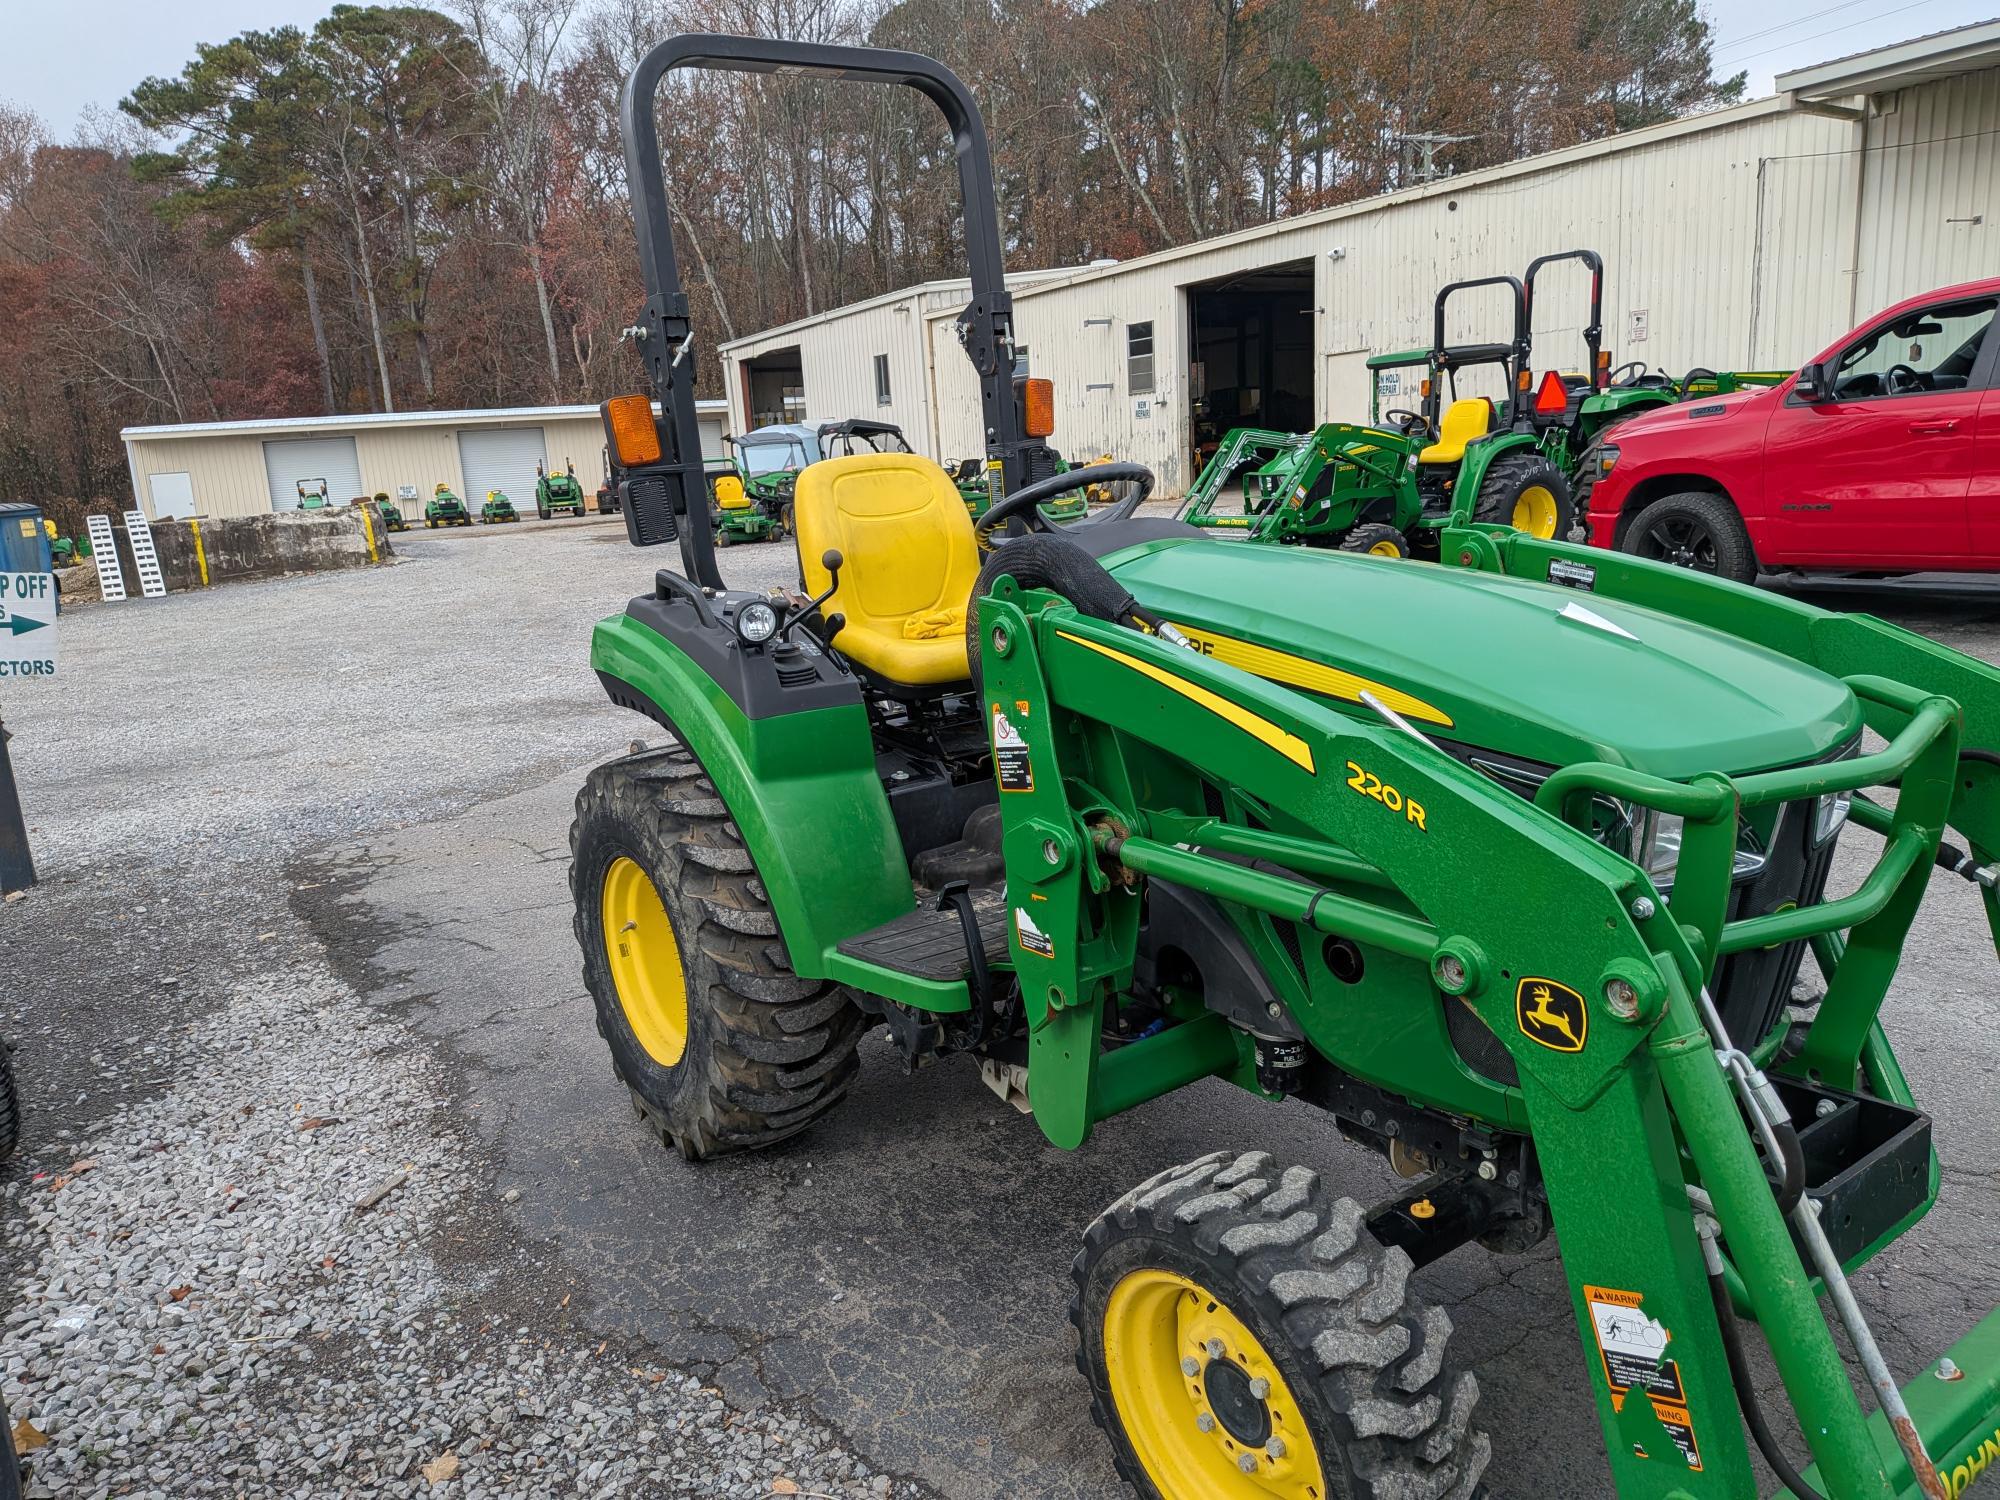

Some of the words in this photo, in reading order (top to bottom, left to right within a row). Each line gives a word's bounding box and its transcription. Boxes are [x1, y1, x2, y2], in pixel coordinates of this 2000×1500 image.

[16, 575, 48, 599] OFF
[1346, 760, 1403, 812] 220
[1406, 797, 1427, 832] R
